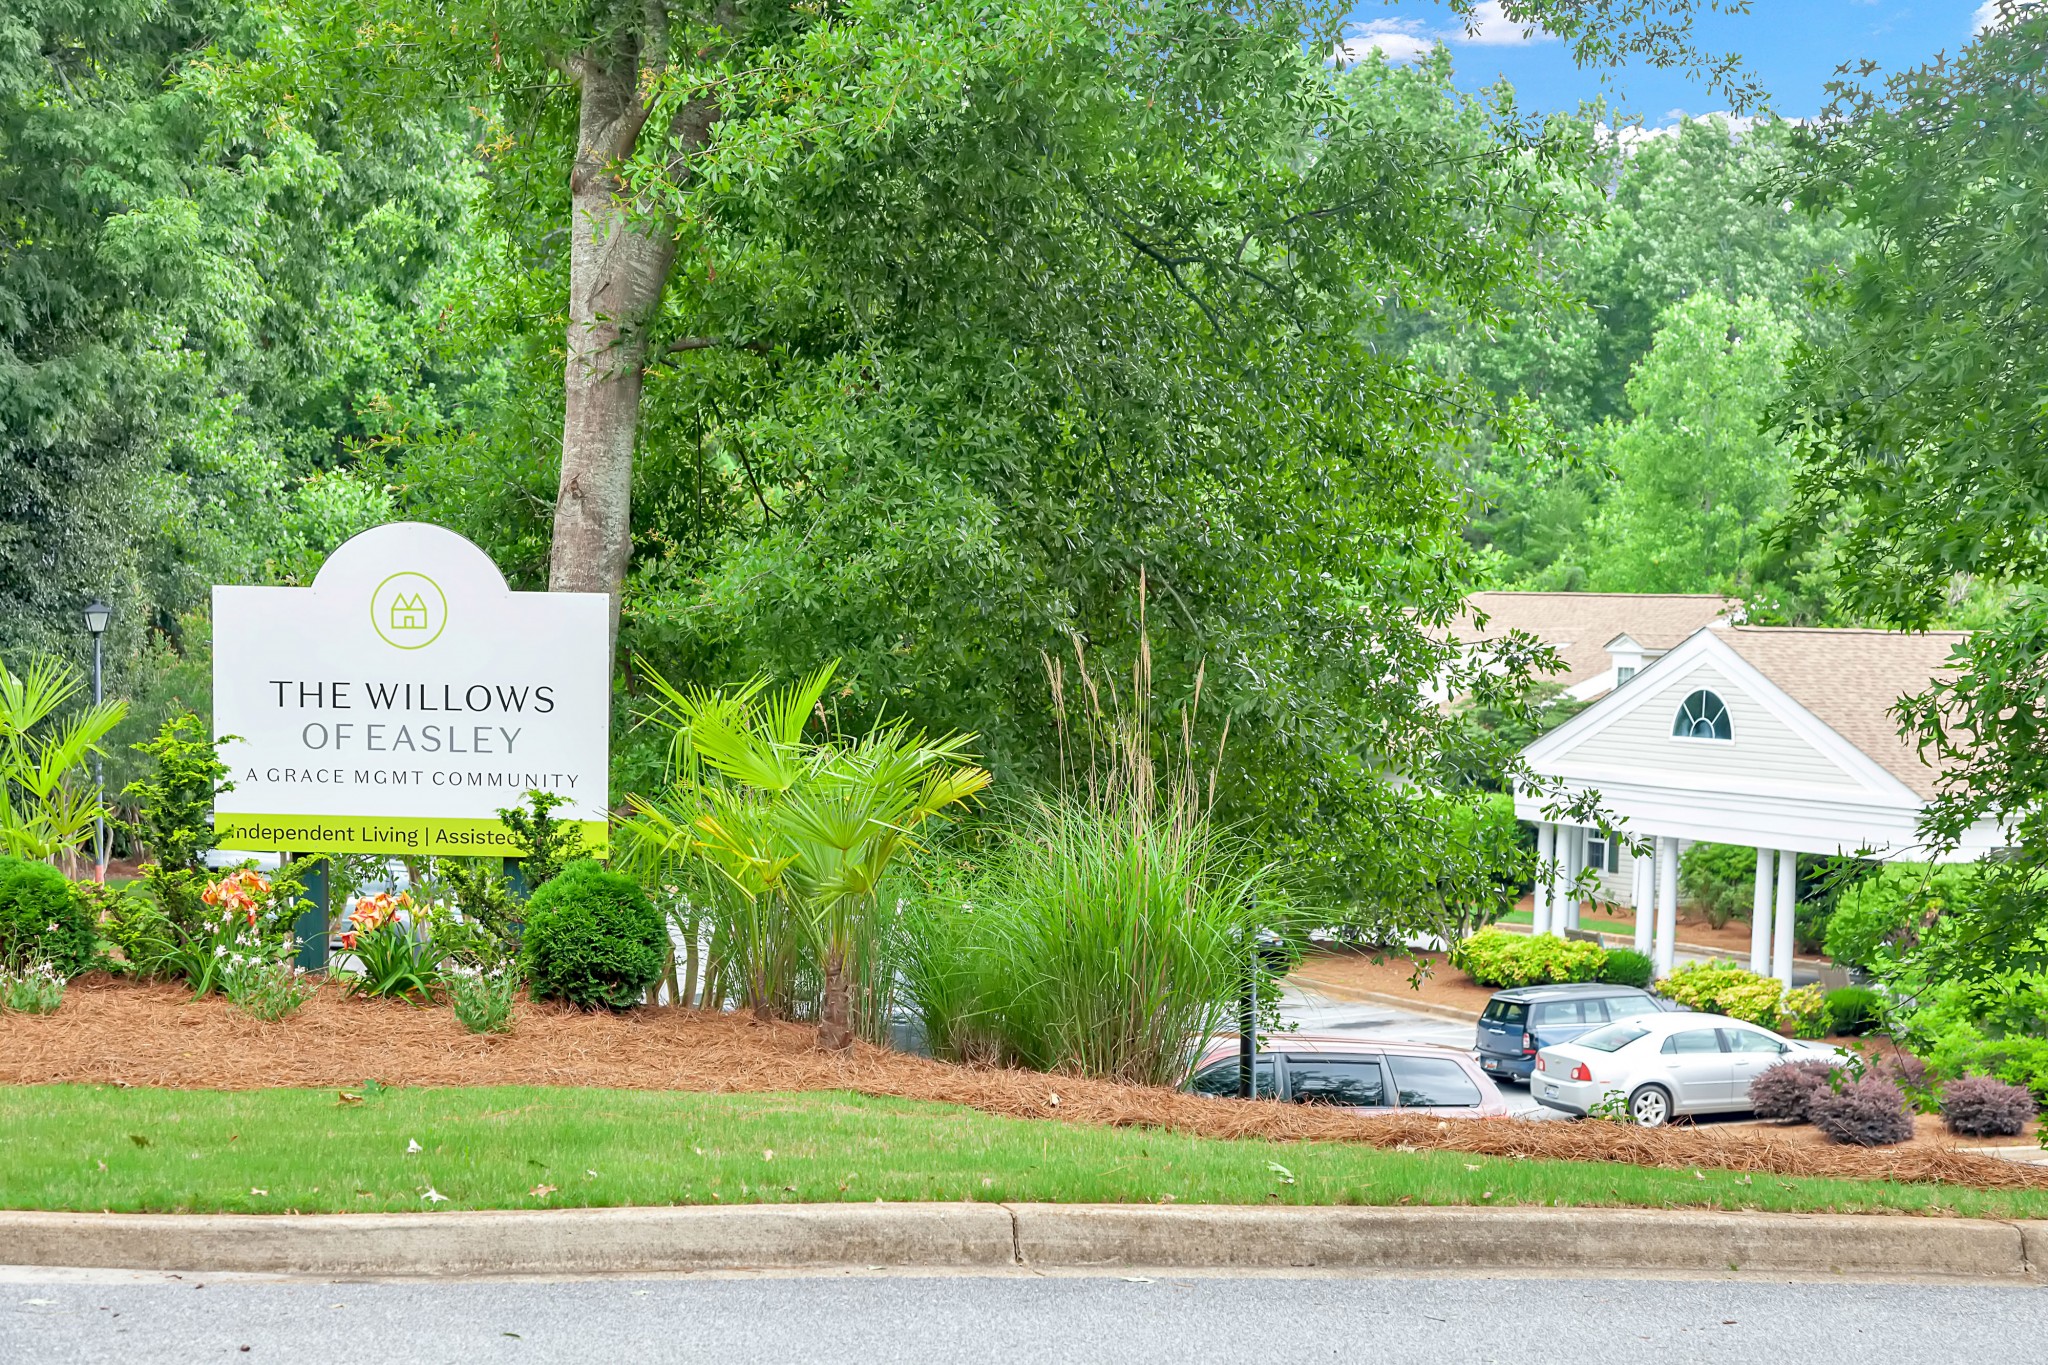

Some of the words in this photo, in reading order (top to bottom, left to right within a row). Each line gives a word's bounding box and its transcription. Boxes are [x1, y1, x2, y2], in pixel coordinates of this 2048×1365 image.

[269, 680, 351, 709] THE
[366, 682, 555, 713] WILLOWS
[302, 722, 354, 750] OF
[367, 723, 522, 754] EASLEY
[245, 767, 258, 782] A
[267, 768, 345, 784] GRACE
[354, 770, 424, 786] MGMT
[432, 771, 580, 788] COMMUNITY
[362, 826, 419, 847] Living
[435, 828, 519, 845] Assisted
